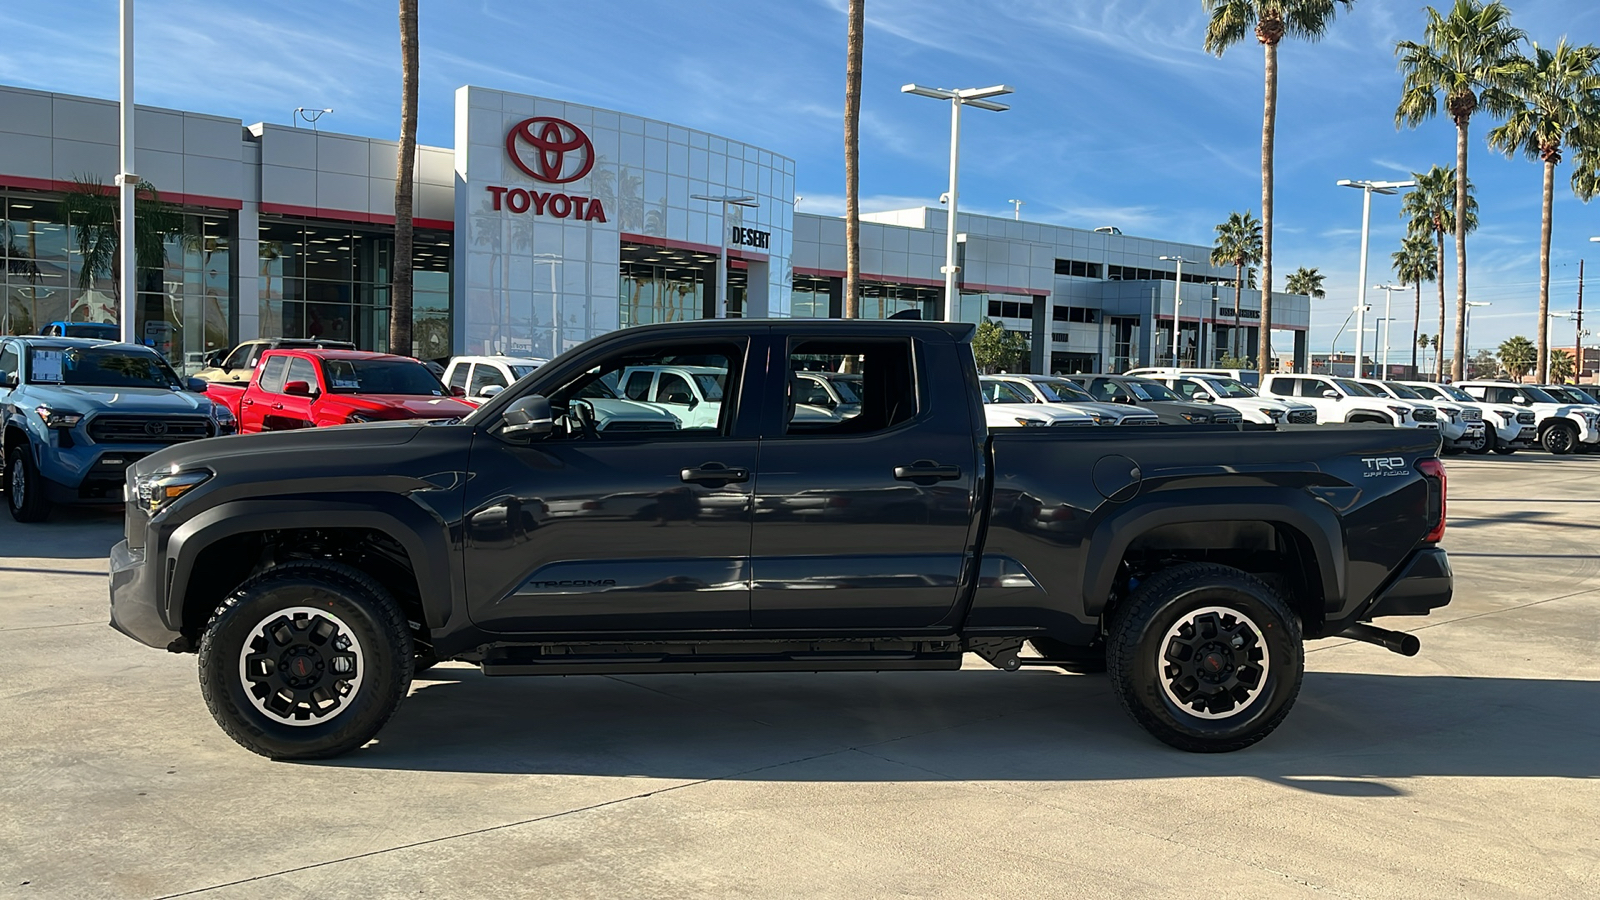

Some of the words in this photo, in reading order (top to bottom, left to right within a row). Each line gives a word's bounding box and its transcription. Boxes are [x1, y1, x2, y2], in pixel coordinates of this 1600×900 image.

[486, 186, 607, 223] TOYOTA
[732, 226, 771, 249] DESERT
[1361, 457, 1404, 470] TRD
[530, 579, 616, 588] TACOMA
